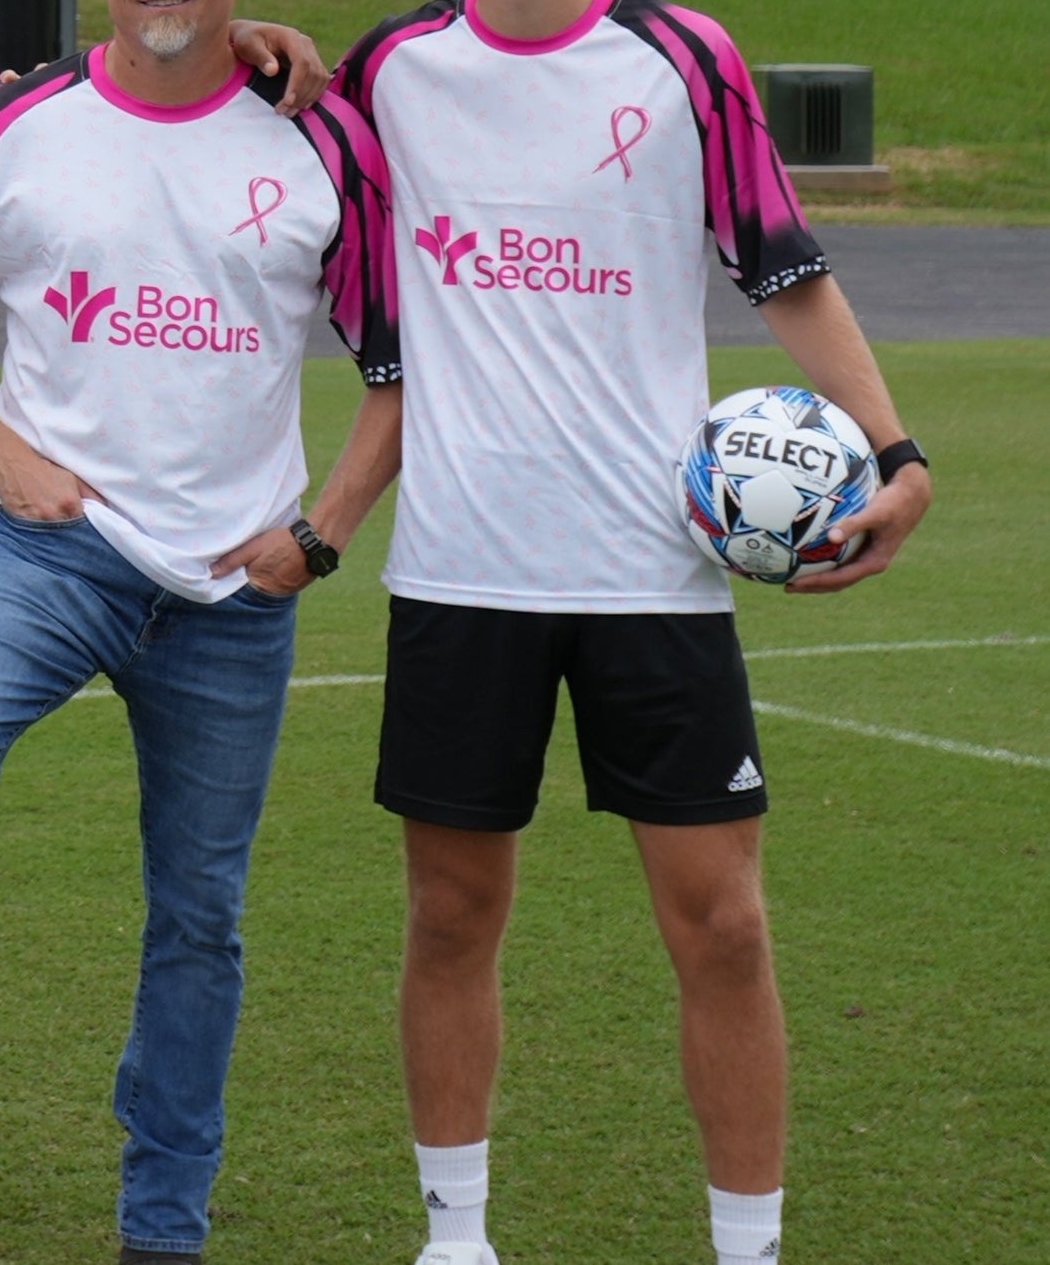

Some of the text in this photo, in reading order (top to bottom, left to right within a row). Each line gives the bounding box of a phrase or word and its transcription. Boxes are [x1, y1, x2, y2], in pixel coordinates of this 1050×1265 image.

[500, 228, 581, 263] Bon
[473, 255, 633, 296] Secours
[137, 285, 219, 322] Bon
[108, 311, 260, 353] Secours
[724, 430, 838, 479] SELECT
